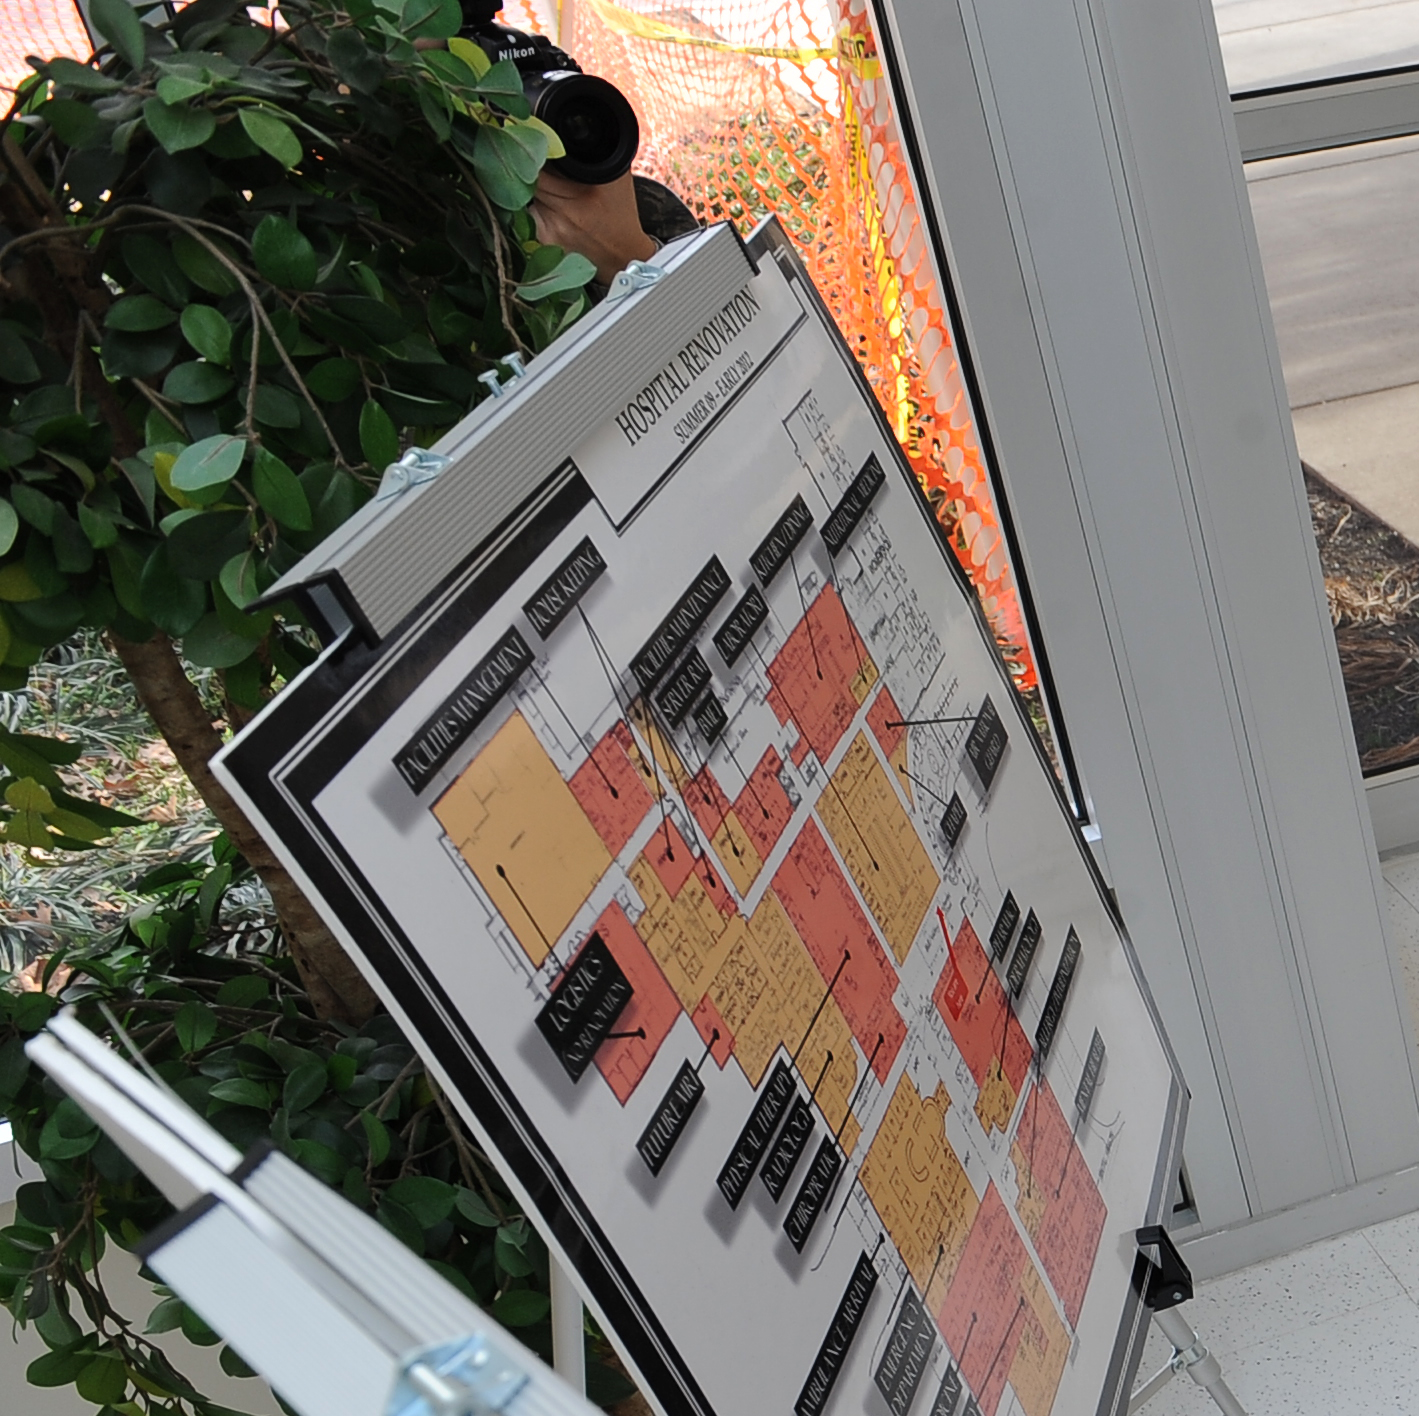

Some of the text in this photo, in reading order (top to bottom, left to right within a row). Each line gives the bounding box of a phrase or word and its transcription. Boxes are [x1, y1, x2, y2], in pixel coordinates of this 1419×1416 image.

[498, 46, 535, 61] Nikon
[614, 284, 762, 447] HOSPITAL RENOVATION
[673, 398, 710, 445] SUMMER
[714, 362, 740, 398] EARLY
[735, 350, 755, 376] 2012
[752, 501, 810, 581] KITCHEN/DINING
[823, 496, 863, 547] NUTRITIONAL
[527, 543, 601, 632] HOUSE KEEPING
[633, 628, 674, 688] FACILITIES
[668, 564, 725, 641] MAINTENANCE
[716, 593, 765, 662] LABORATORY
[398, 635, 528, 786] FACILITIES MANAGEMENT
[662, 665, 695, 723] SERVER
[687, 648, 709, 686] RM
[547, 949, 603, 1034] LOGISTICS
[640, 1068, 701, 1168] FUTURE MRI
[720, 1069, 792, 1203] PHYSICAL THERAPY
[764, 1105, 811, 1195] RADIOLOGY
[841, 1260, 875, 1339] ARRIVAL
[878, 1300, 921, 1393] EMERGENCY
